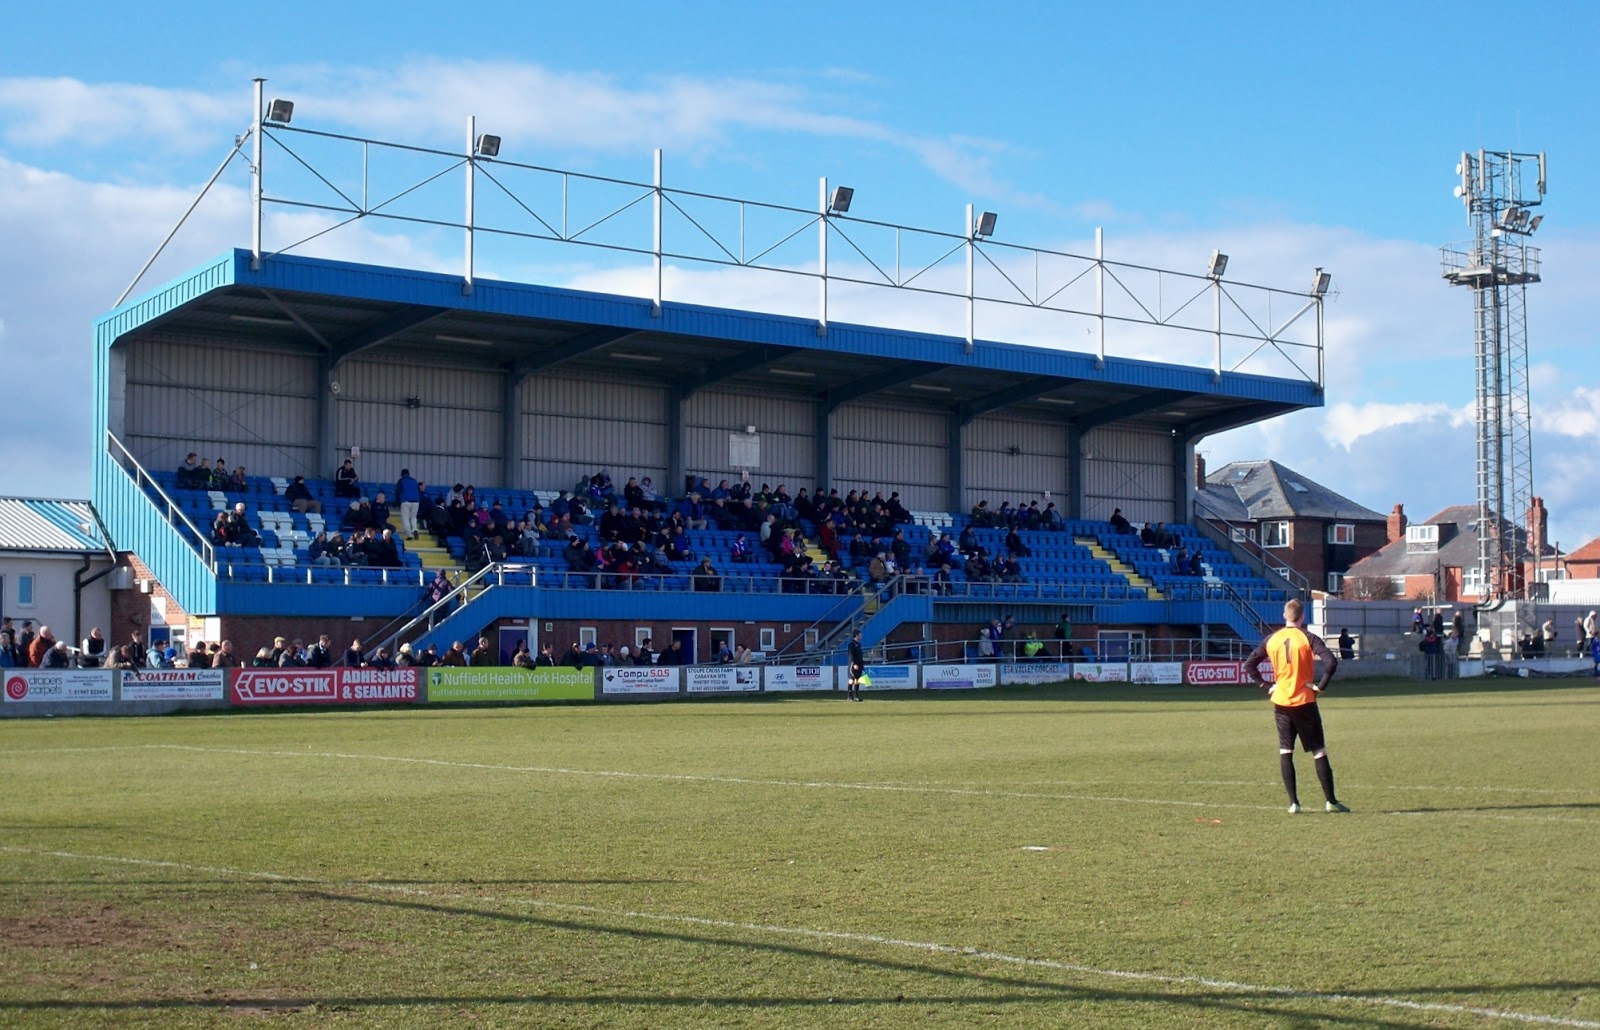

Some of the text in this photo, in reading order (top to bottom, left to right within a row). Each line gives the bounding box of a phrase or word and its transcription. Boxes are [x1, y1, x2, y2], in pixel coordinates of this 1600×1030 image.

[1284, 638, 1291, 664] 1
[618, 670, 648, 678] Compu
[1015, 665, 1034, 673] VALLEY
[1034, 665, 1059, 673] COACHES
[138, 671, 221, 681] COATHAM Coaches
[342, 670, 416, 683] ADHESIVES
[444, 672, 592, 686] Nuffield Health York Hospital
[29, 676, 62, 688] drapers
[29, 686, 62, 696] carpets
[342, 685, 416, 699] & SEALANTS
[432, 688, 539, 696] nuffieldhealth.com/yorkhospital
